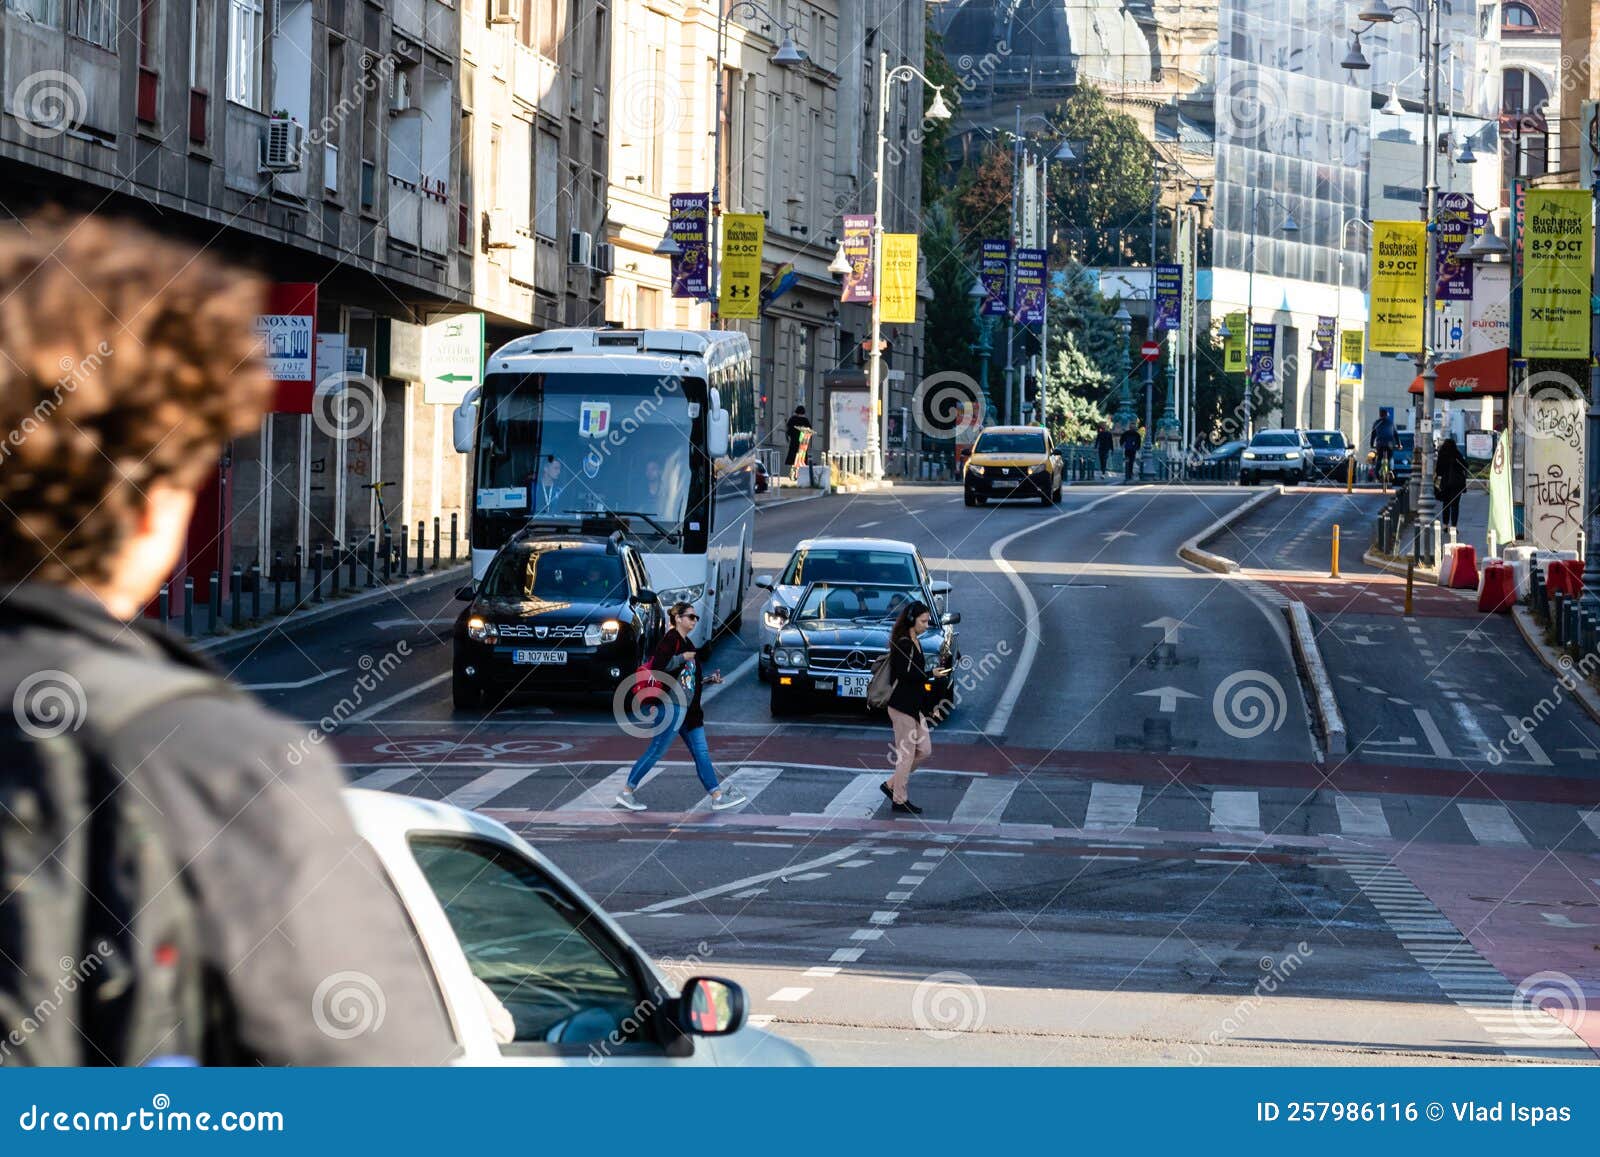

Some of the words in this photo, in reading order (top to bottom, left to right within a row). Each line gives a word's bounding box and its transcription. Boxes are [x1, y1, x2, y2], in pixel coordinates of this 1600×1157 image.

[1532, 215, 1582, 226] Bucharest
[1532, 226, 1582, 235] MARATHON
[741, 244, 758, 252] OCT
[1379, 241, 1417, 250] Bucharest
[1532, 239, 1552, 251] 8-9
[1556, 240, 1583, 252] OCT
[1379, 249, 1417, 257] MARATHON
[1378, 260, 1394, 269] 8-9
[1397, 261, 1418, 270] OCT
[291, 316, 307, 327] SA
[1545, 314, 1565, 322] Bank
[844, 676, 852, 686] B
[849, 687, 863, 696] AIR
